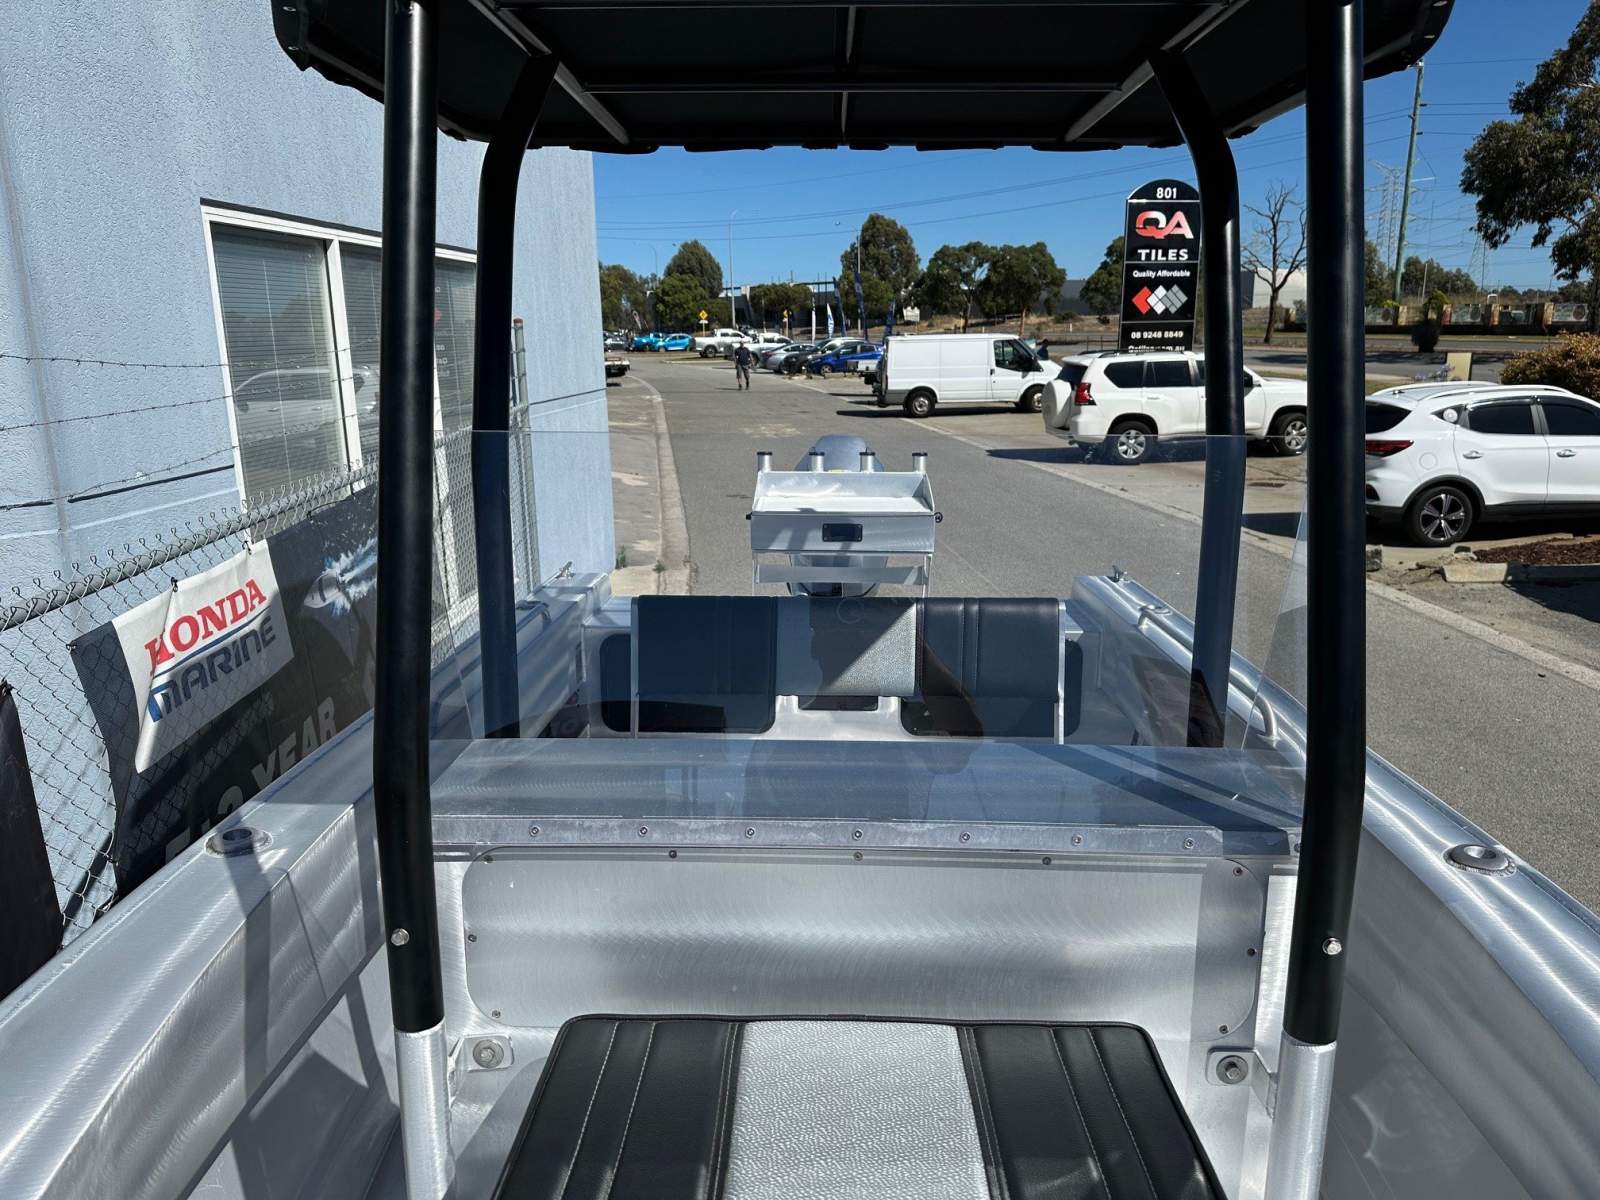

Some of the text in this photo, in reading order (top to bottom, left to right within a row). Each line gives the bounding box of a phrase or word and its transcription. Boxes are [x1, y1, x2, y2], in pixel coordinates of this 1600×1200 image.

[1156, 187, 1177, 199] 801
[1135, 210, 1194, 239] QA
[1137, 249, 1189, 261] TILES
[1133, 269, 1191, 279] Quality Affordable
[1131, 331, 1141, 339] 08
[147, 614, 276, 722] MARINE
[251, 696, 337, 790] YEAR
